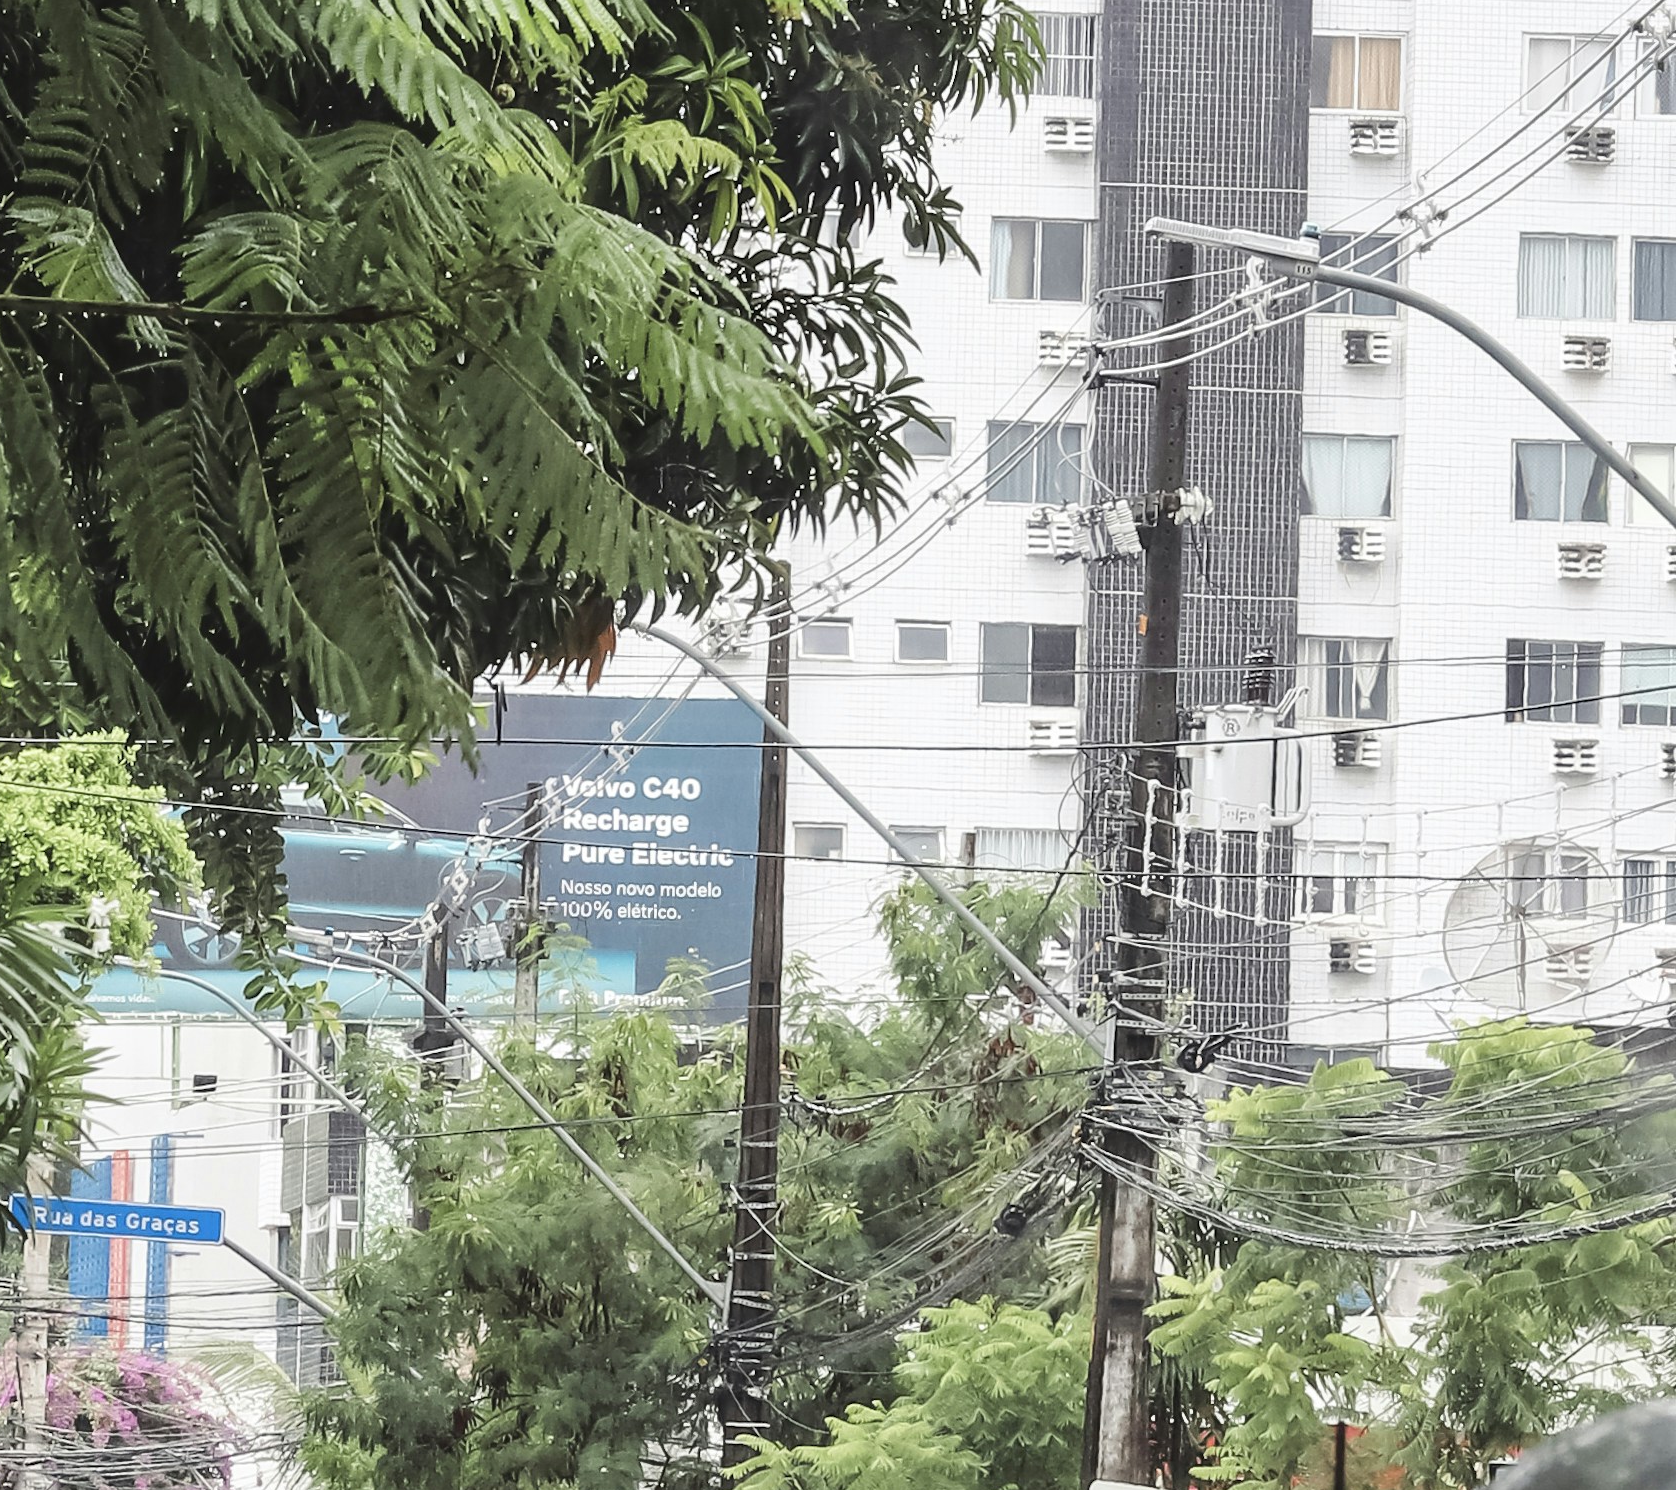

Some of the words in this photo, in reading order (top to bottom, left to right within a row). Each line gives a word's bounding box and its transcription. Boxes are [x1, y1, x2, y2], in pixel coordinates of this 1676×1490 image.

[562, 775, 636, 799] Volvo
[643, 776, 701, 800] C40
[563, 808, 690, 837] Recharge
[562, 843, 625, 864] Pure
[632, 842, 734, 867] Electric
[561, 879, 612, 895] Nosso
[616, 883, 655, 897] novo
[660, 881, 722, 898] modelo
[561, 901, 613, 919] 100%
[34, 1205, 73, 1226] Rua
[79, 1210, 117, 1228] das
[126, 1213, 200, 1236] Graças
